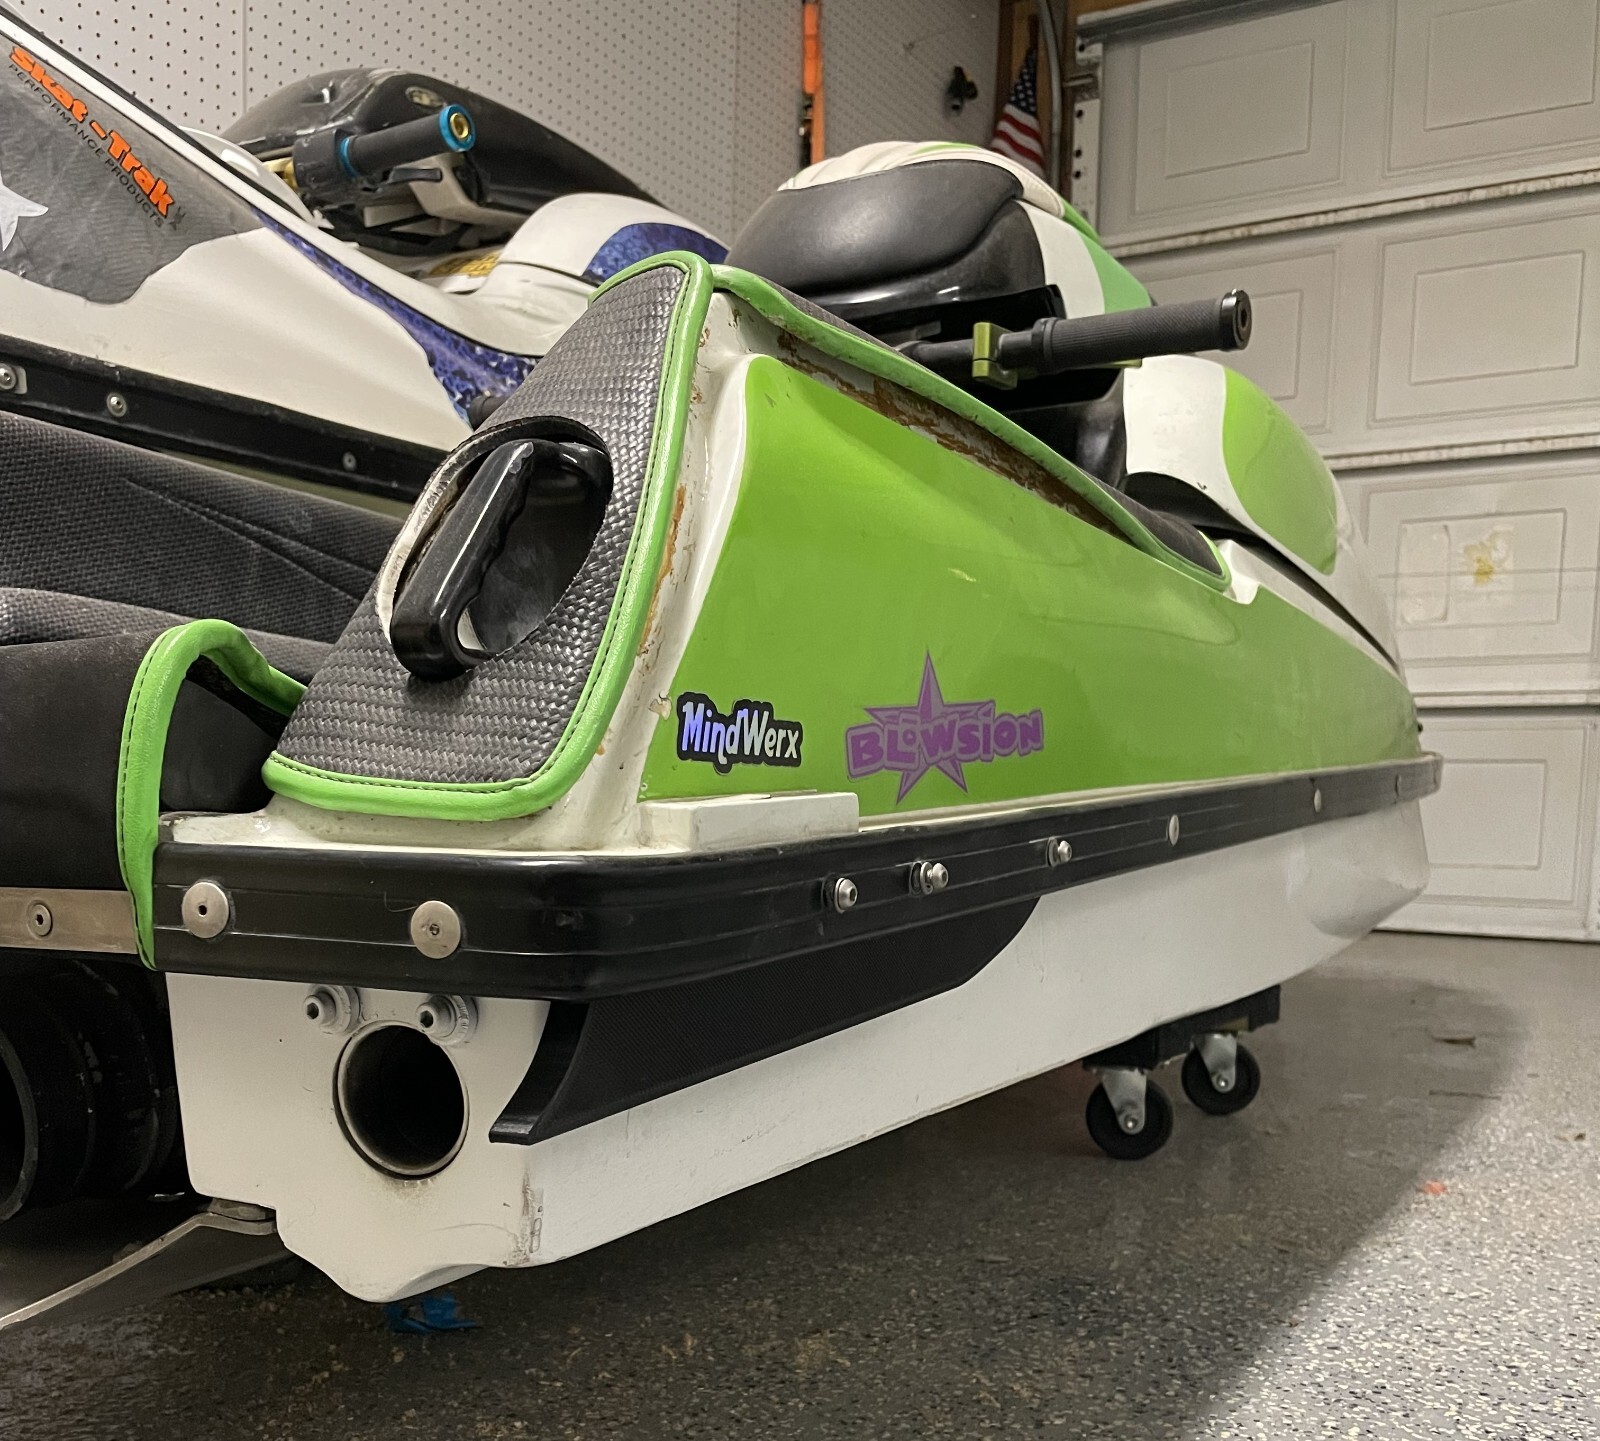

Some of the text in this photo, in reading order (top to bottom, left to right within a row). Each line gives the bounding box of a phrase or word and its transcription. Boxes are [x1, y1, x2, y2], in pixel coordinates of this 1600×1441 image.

[9, 46, 175, 218] Skat-Trak
[9, 63, 164, 228] PERFORMANCE PRODUCTS
[681, 701, 799, 765] MindWerx
